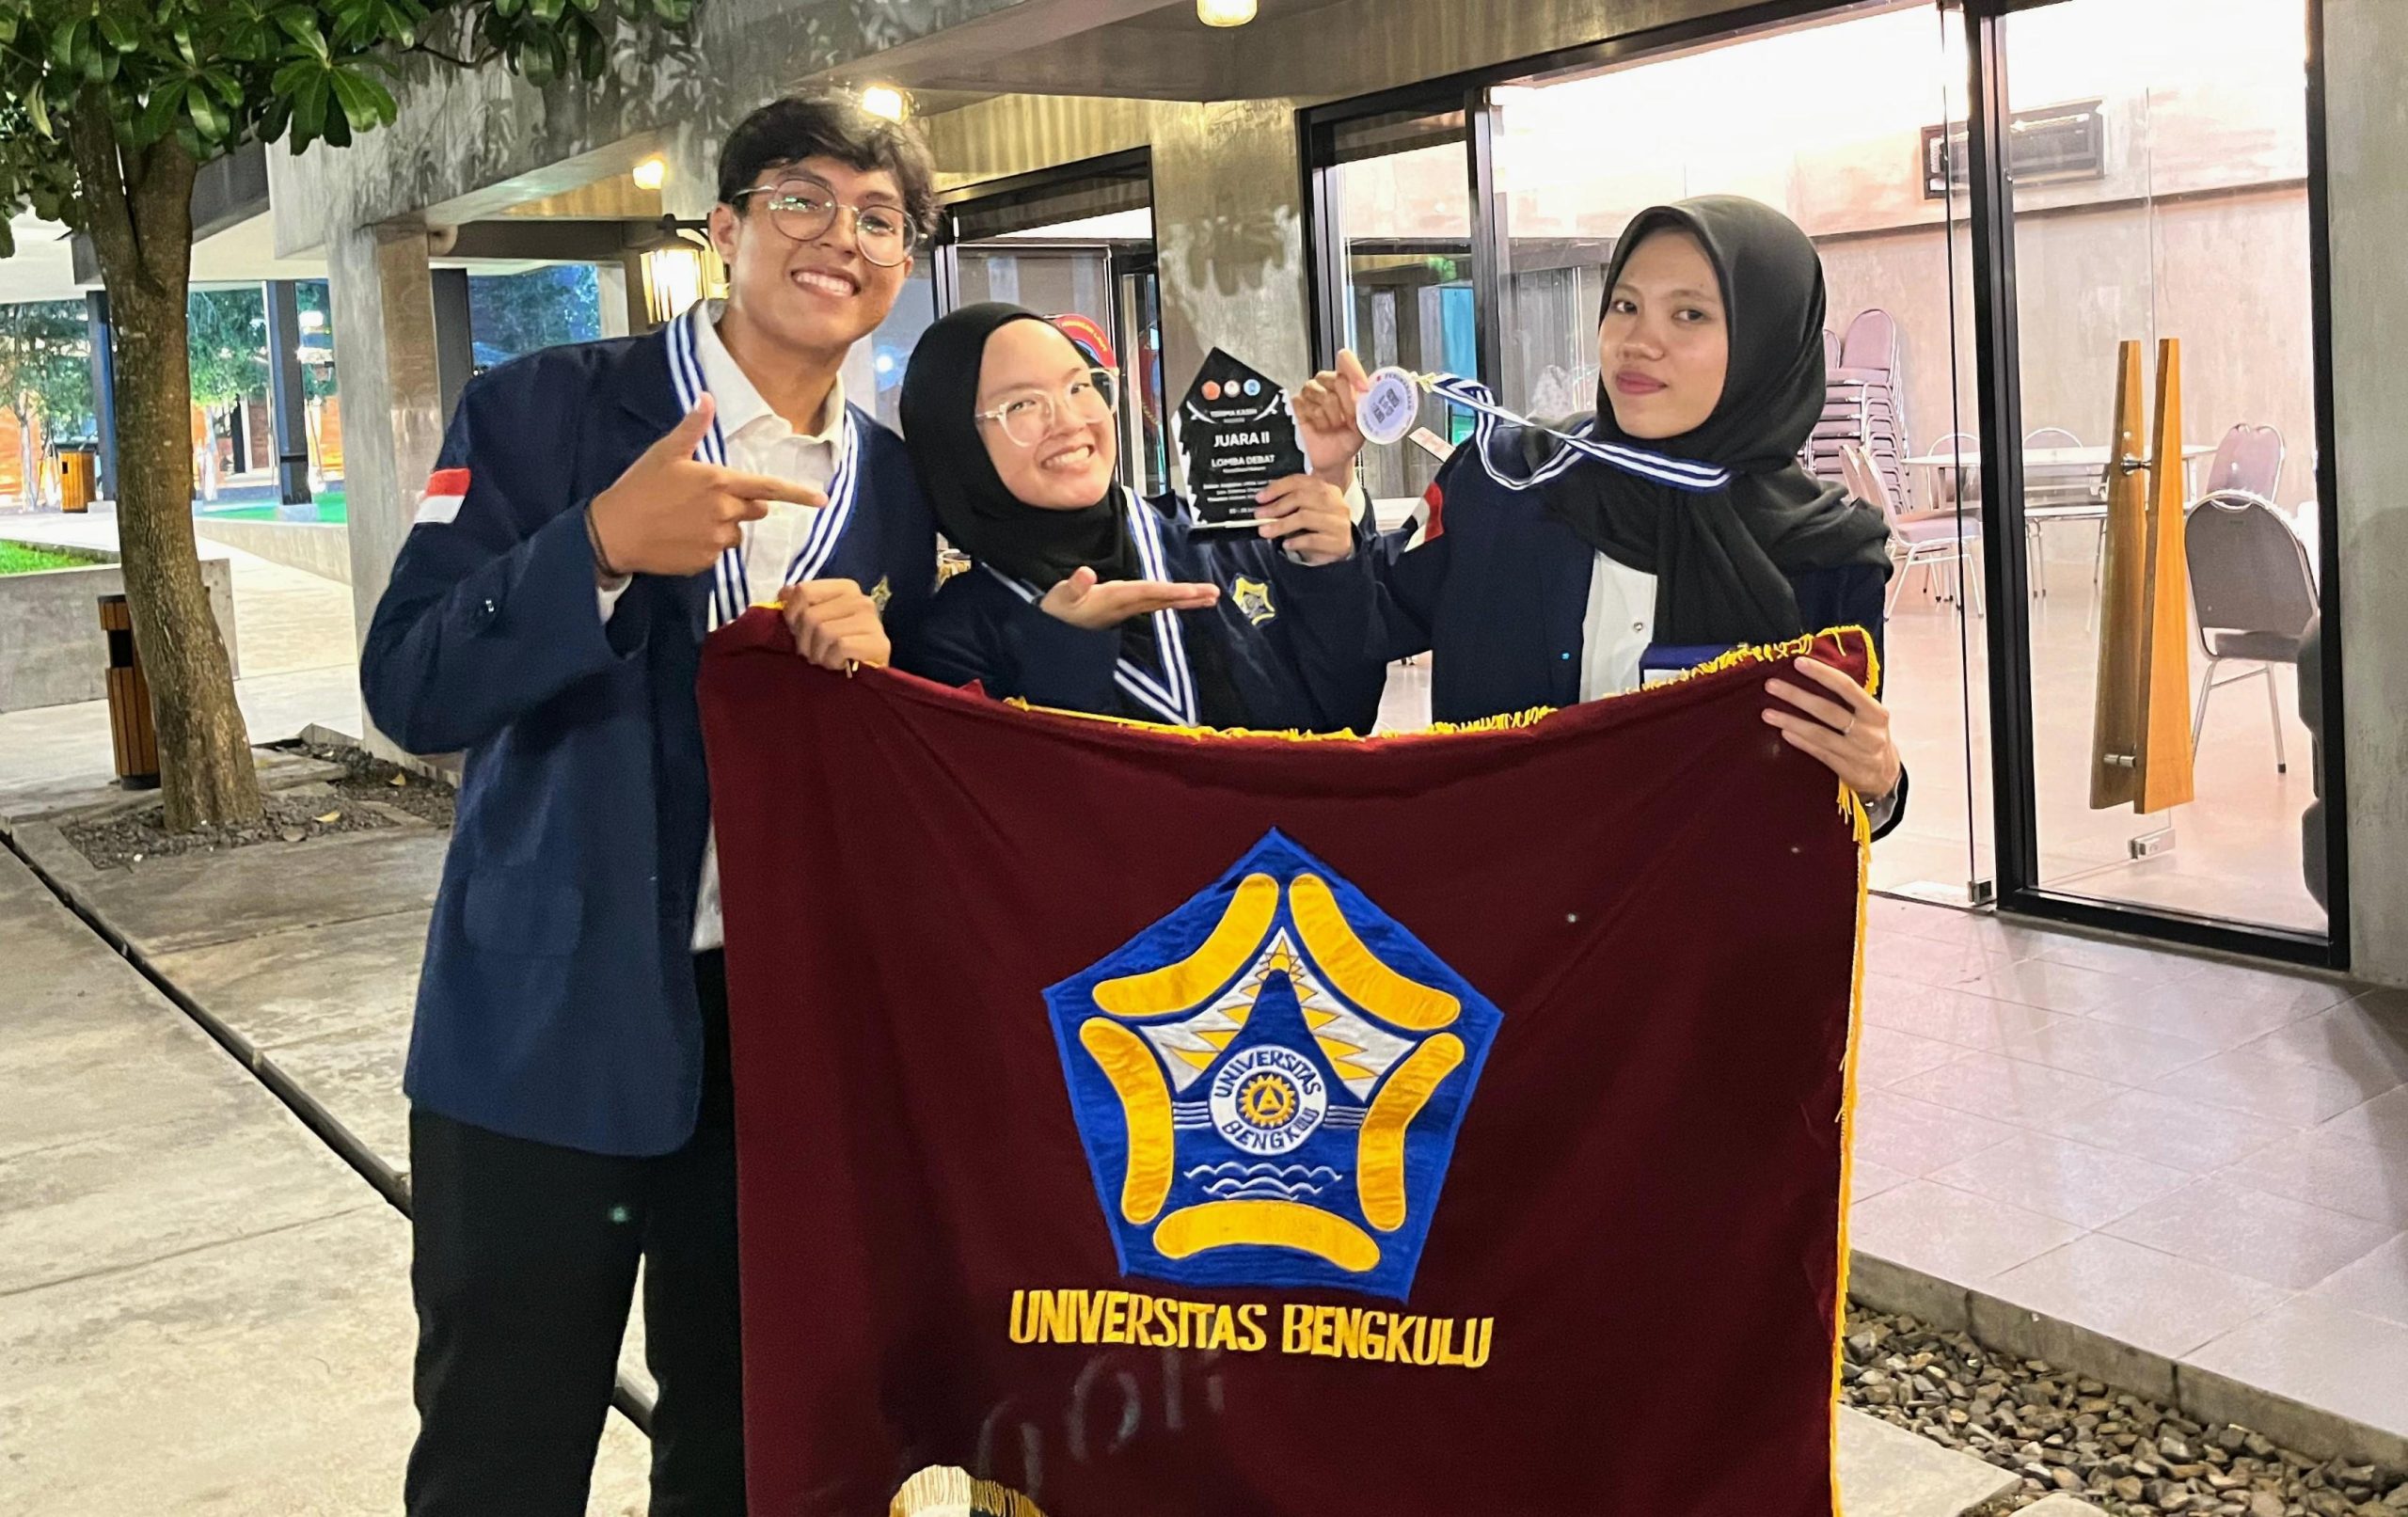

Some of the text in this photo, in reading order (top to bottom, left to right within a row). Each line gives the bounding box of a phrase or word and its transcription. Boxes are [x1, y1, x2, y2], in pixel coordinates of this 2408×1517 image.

[1213, 431, 1270, 448] JUARA II
[1211, 454, 1275, 467] LOMBA DEBAT
[1214, 1050, 1322, 1098] UNIVERSITAS
[1009, 1289, 1494, 1368] UNIVERSITAS BENGKULU
